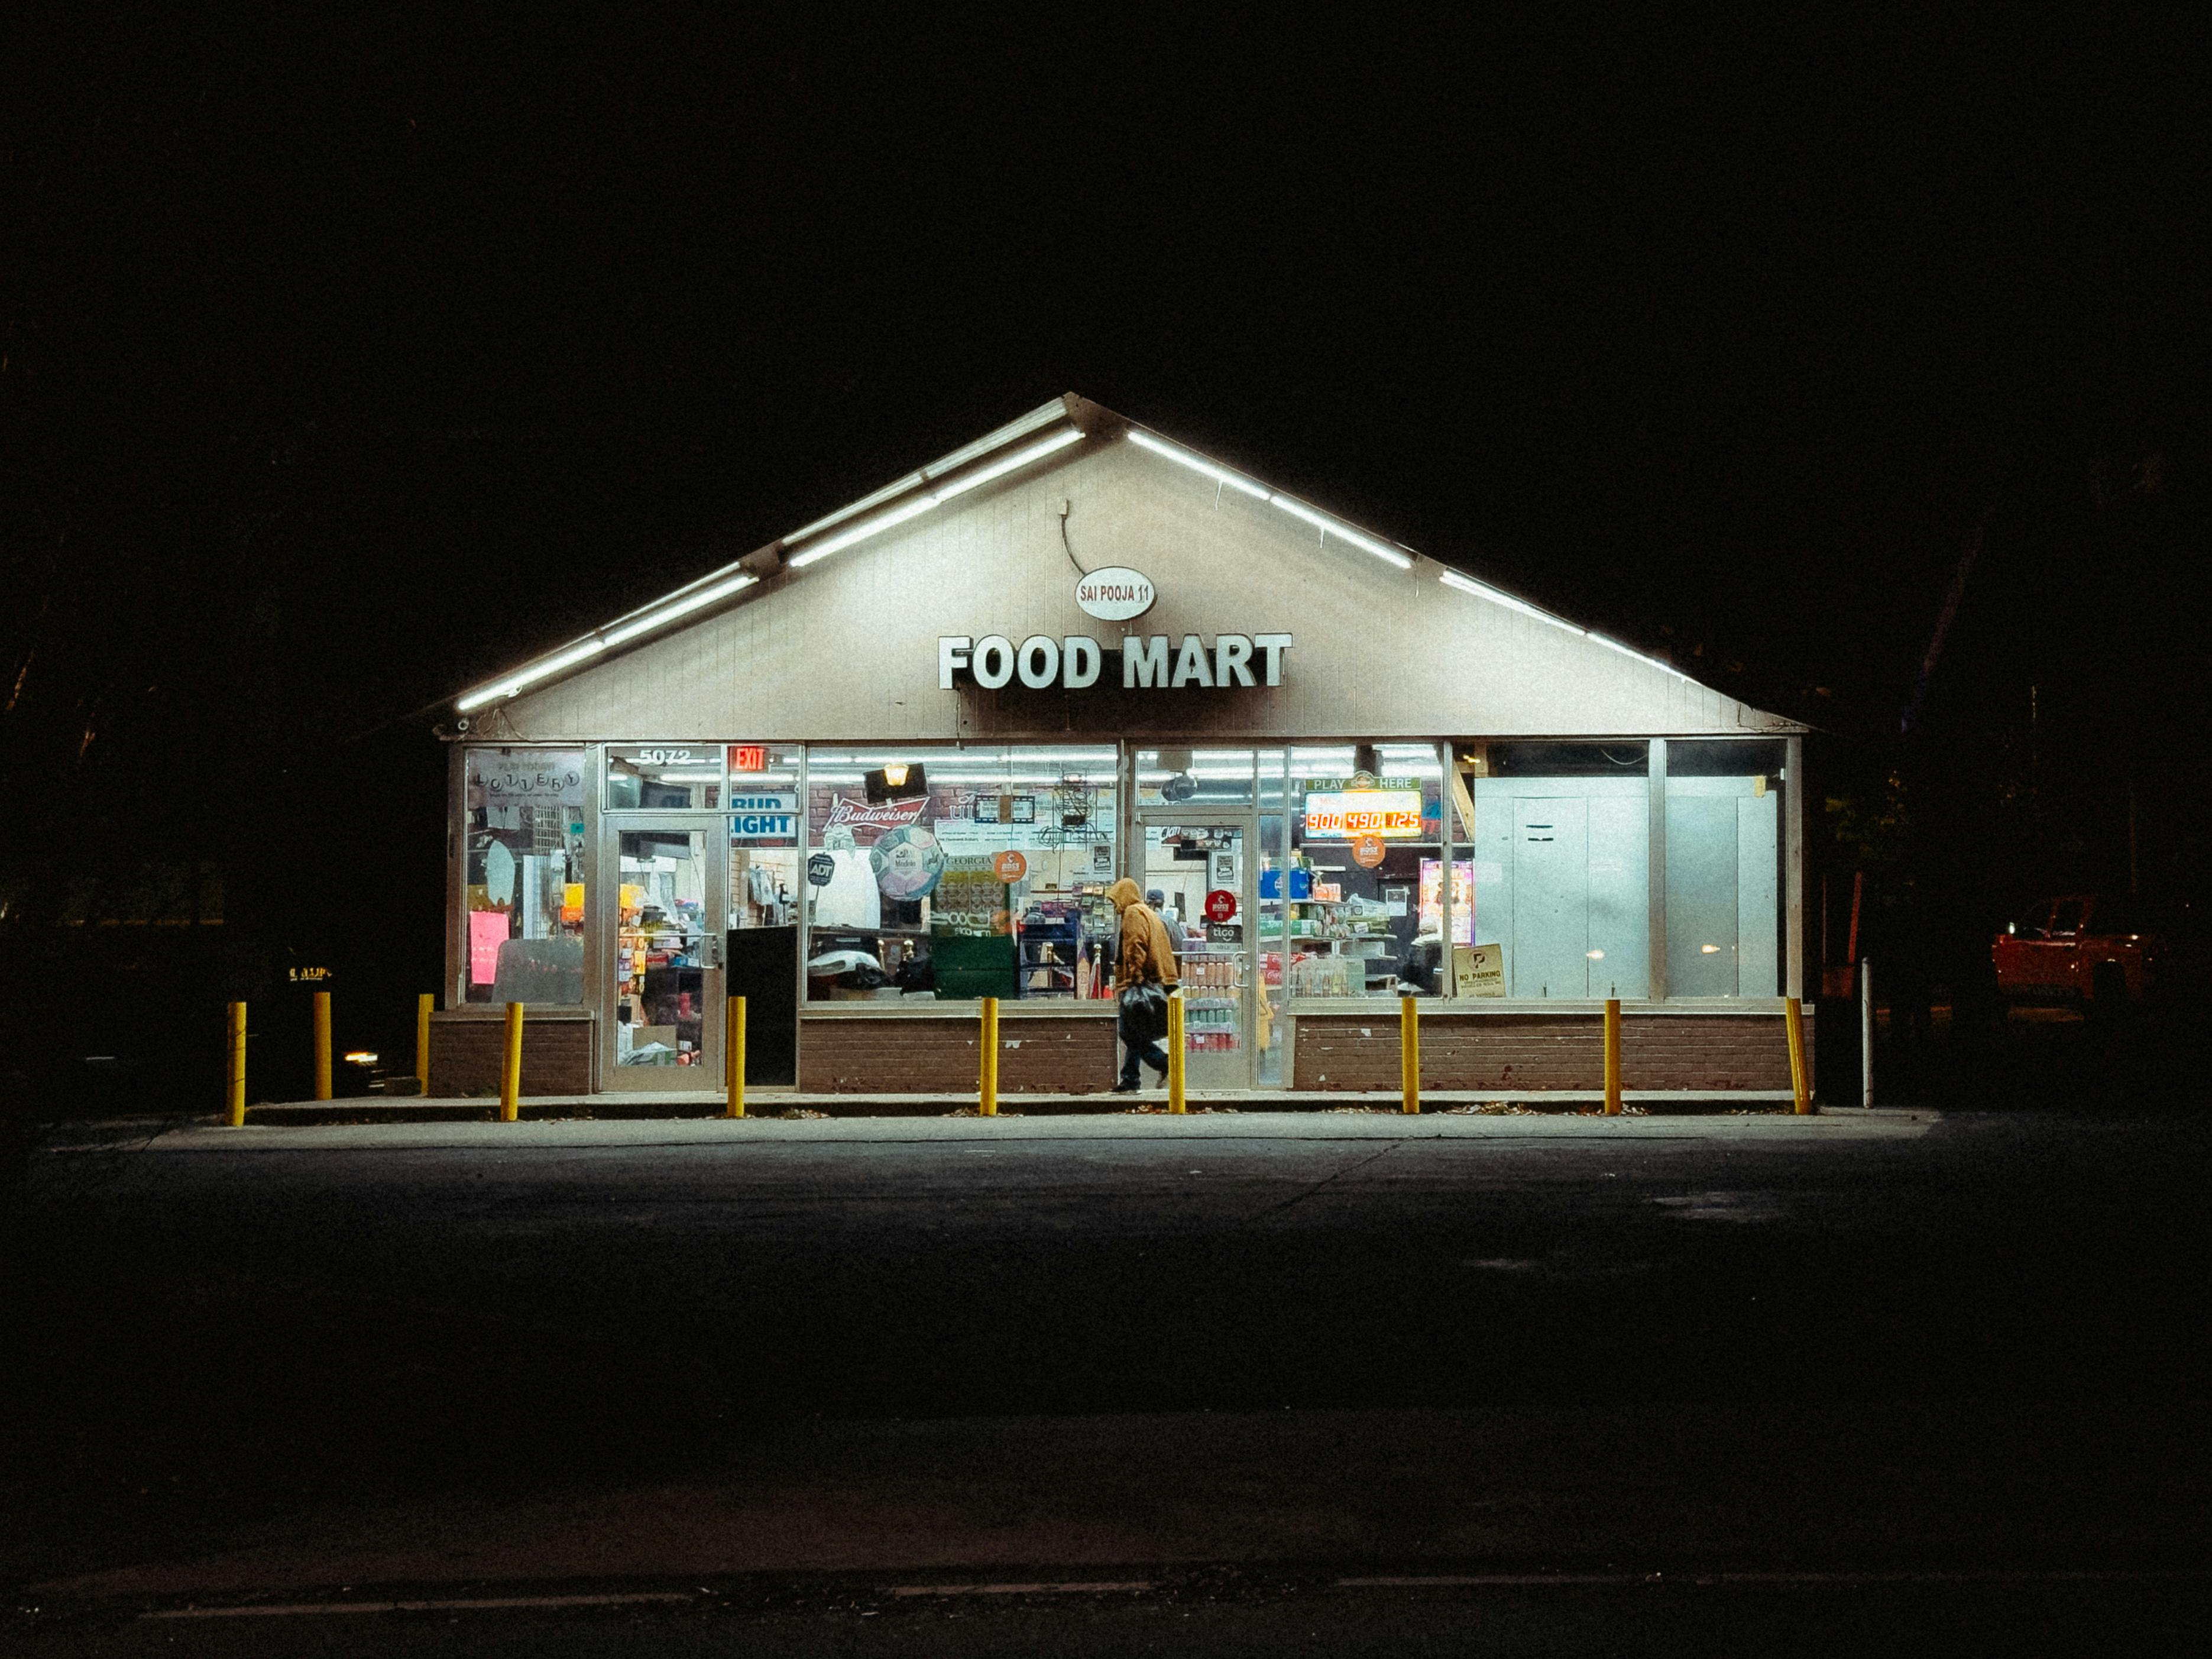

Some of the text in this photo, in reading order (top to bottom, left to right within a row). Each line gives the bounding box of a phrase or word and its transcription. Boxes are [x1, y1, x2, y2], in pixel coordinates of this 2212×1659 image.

[1080, 585, 1097, 601] SAI
[1100, 585, 1135, 601] POOJA
[938, 633, 1294, 690] FOOD MART
[639, 750, 691, 765] 5072
[736, 747, 765, 770] EXIT
[475, 770, 580, 792] LOTTERY
[1314, 780, 1345, 789] PLAY
[1379, 778, 1411, 788] HERE
[830, 804, 919, 823] Budweiser
[1309, 812, 1420, 828] 900 490 125
[731, 816, 790, 833] IGHT
[946, 857, 992, 865] GEORGIA
[810, 864, 833, 876] ADT
[1213, 928, 1234, 937] tigo
[1472, 970, 1501, 980] PARKING
